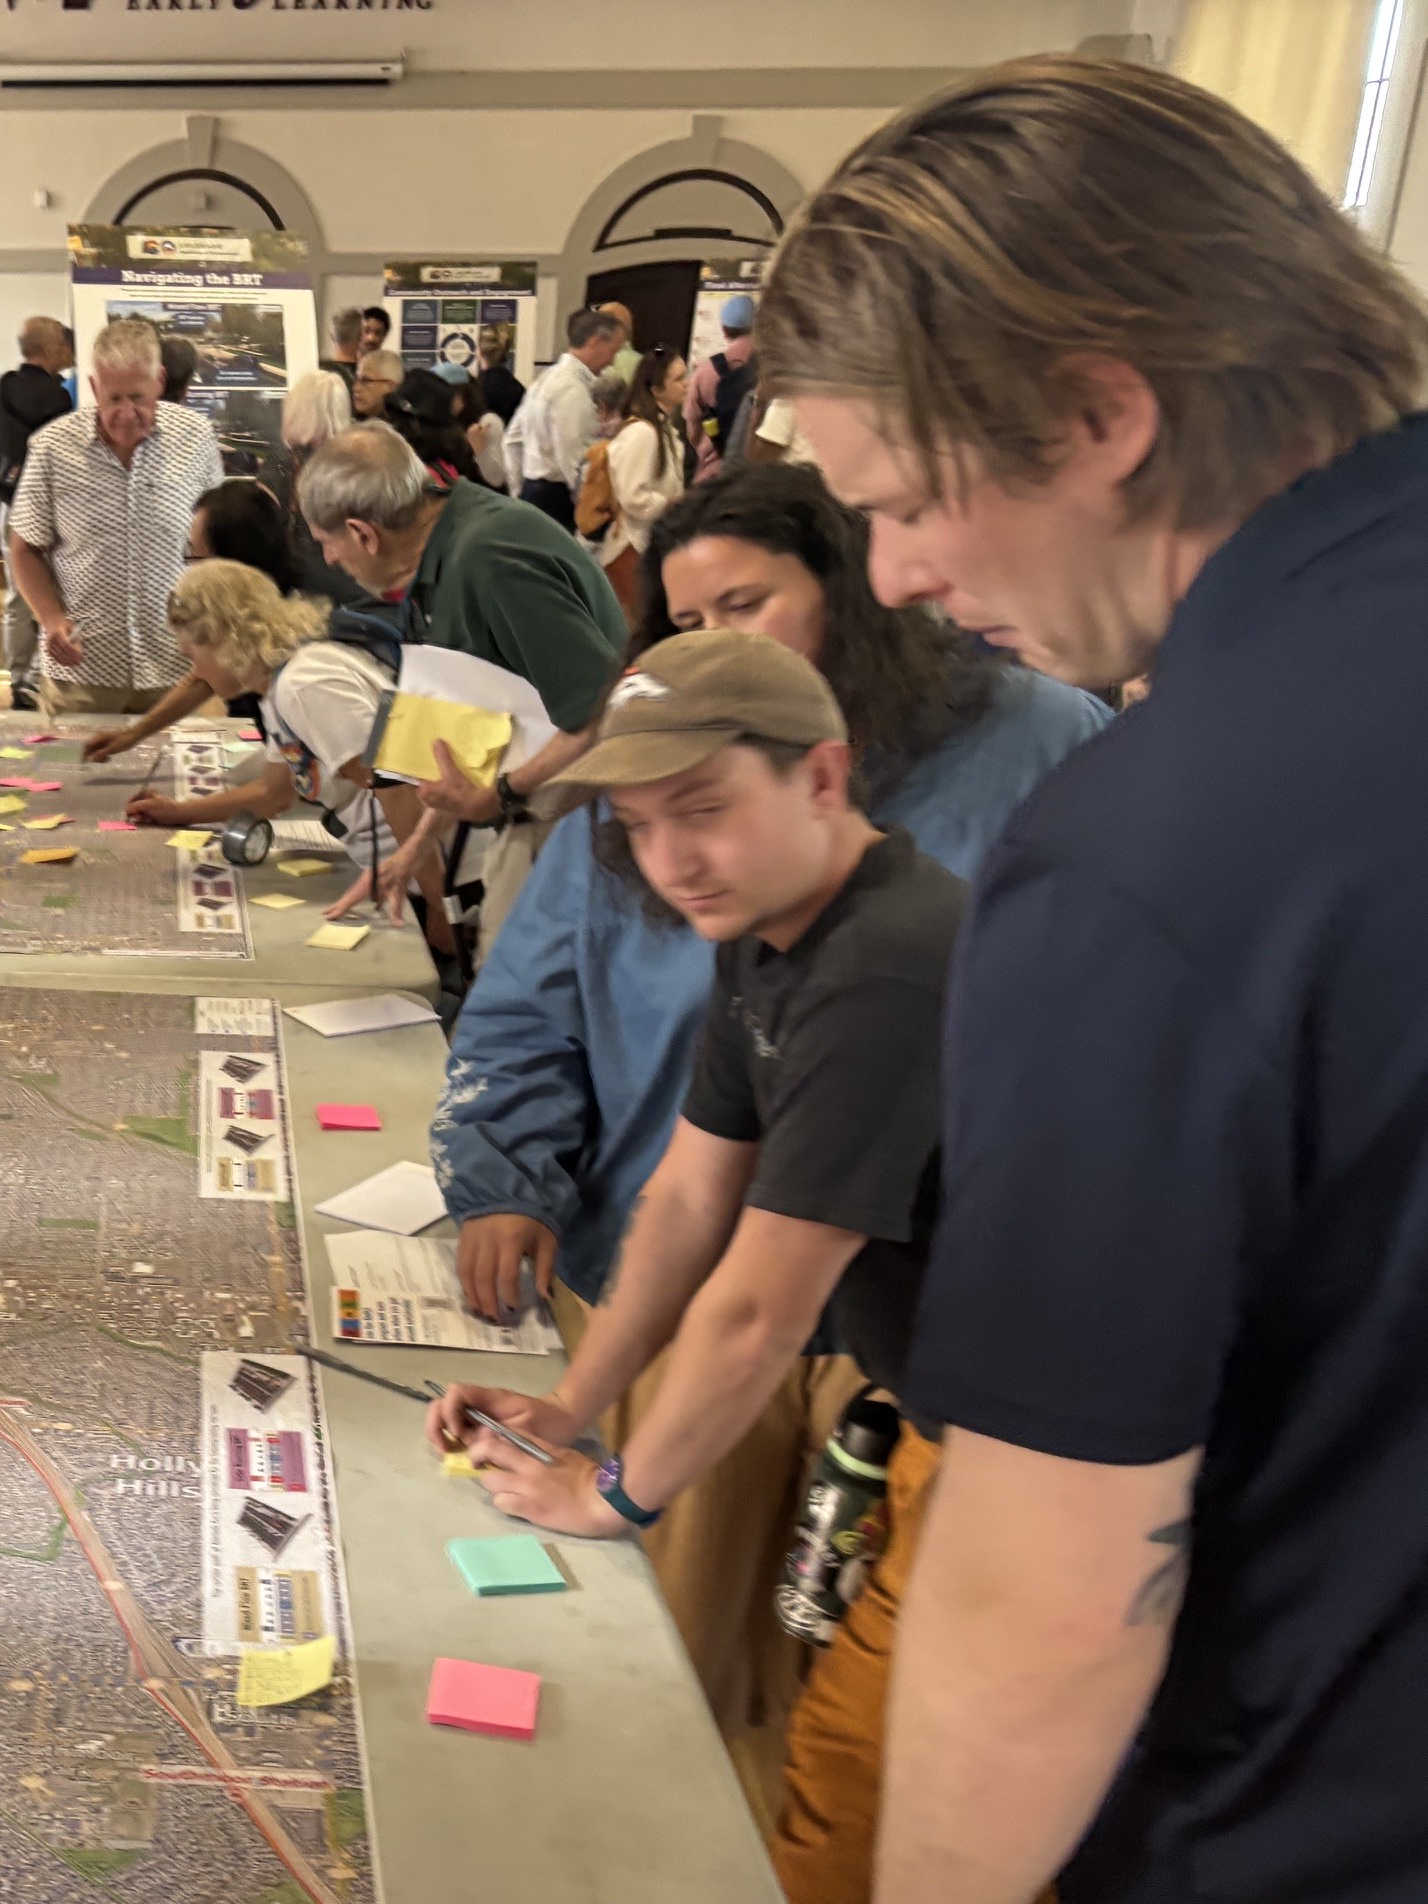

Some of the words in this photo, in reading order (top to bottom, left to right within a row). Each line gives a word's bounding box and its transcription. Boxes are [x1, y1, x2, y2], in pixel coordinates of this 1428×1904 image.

[121, 270, 203, 287] Navigating
[205, 272, 230, 285] the
[232, 273, 263, 286] BRT
[111, 1454, 202, 1479] Holly
[117, 1479, 202, 1498] Hills
